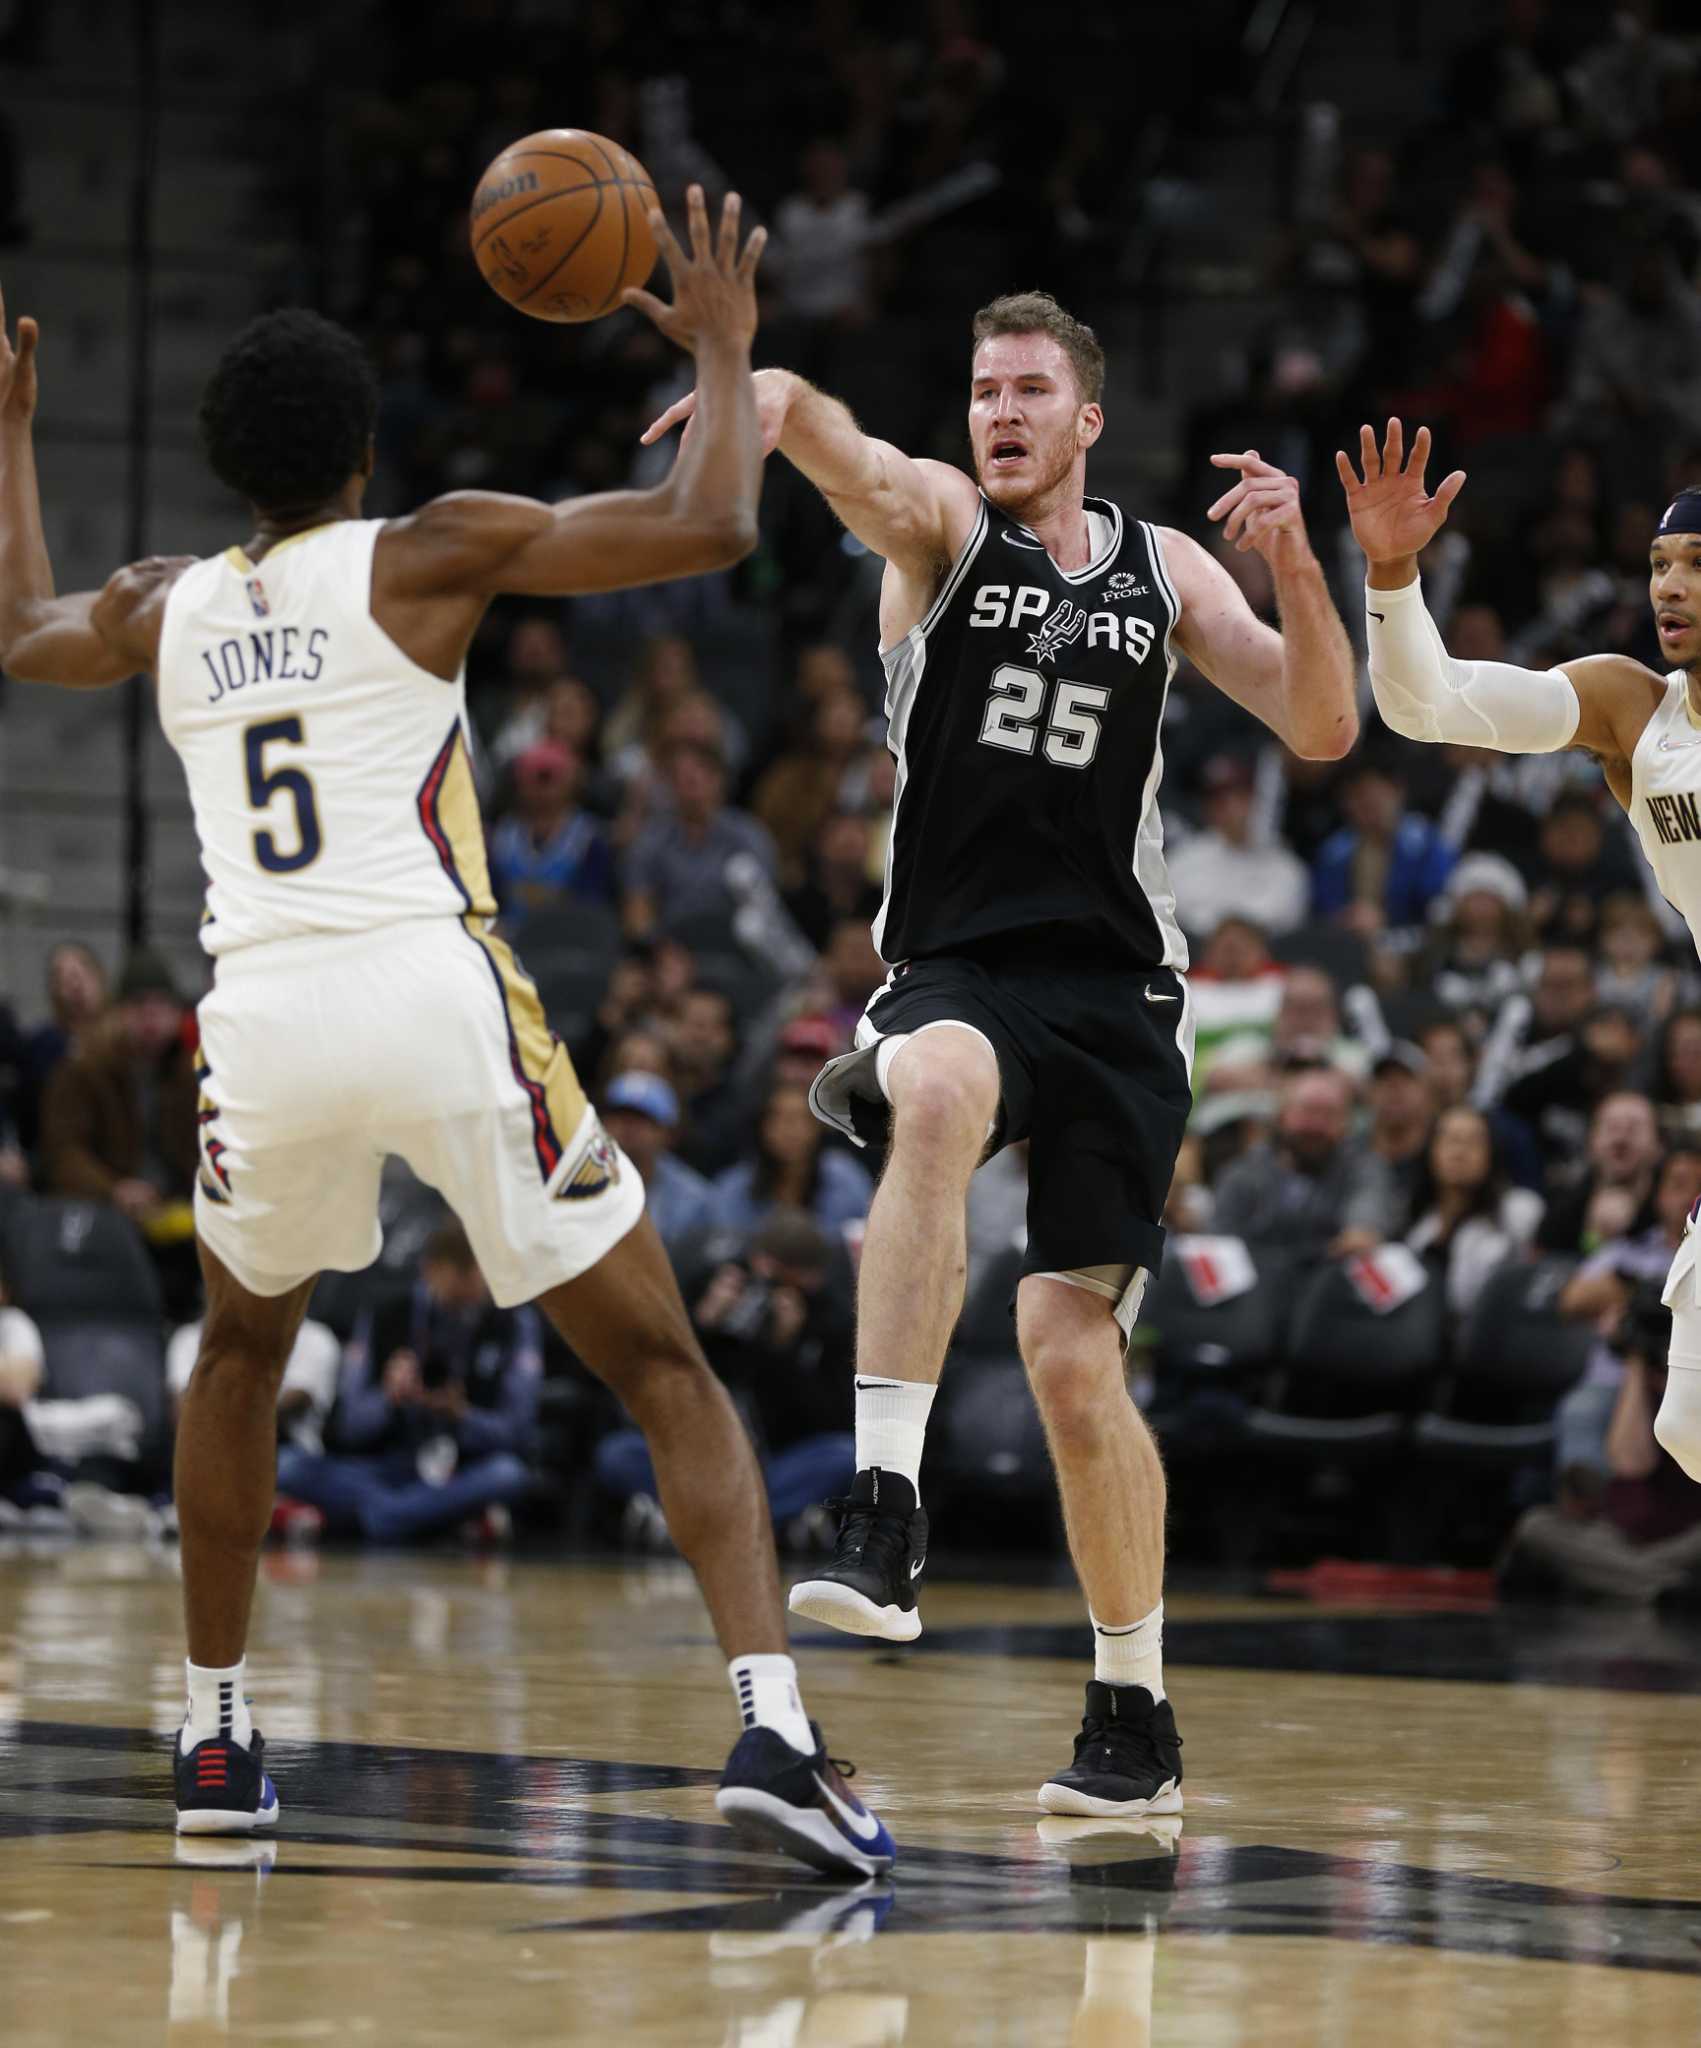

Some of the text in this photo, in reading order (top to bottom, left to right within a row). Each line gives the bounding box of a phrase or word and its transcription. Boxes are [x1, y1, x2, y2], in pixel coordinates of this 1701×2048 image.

[202, 627, 329, 703] JONES
[969, 585, 1156, 665] SPURS
[978, 662, 1112, 770] 25
[242, 710, 324, 877] 5
[1645, 792, 1701, 845] NEW
